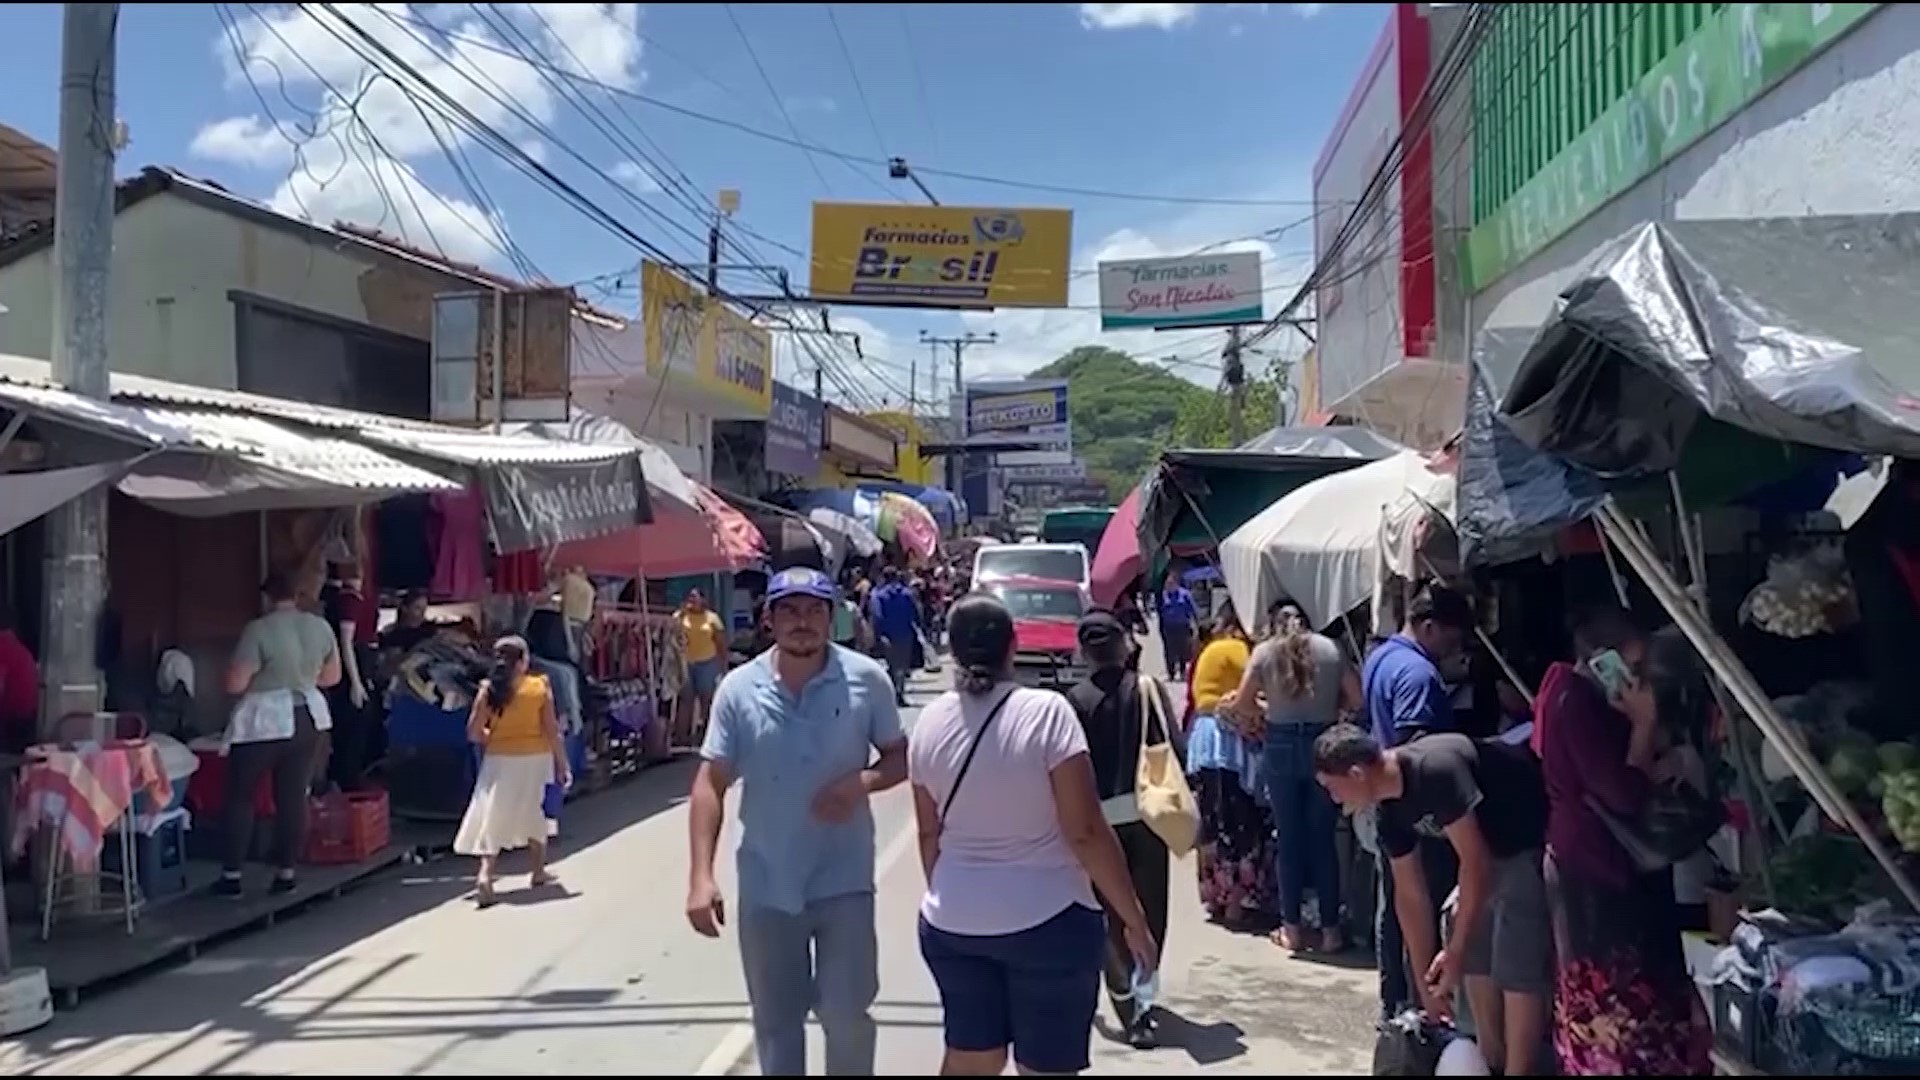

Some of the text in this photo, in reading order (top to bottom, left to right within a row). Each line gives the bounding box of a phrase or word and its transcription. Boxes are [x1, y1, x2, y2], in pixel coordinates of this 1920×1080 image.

[864, 226, 970, 245] Farmacias
[1131, 260, 1229, 284] farmacias
[1124, 286, 1161, 313] San
